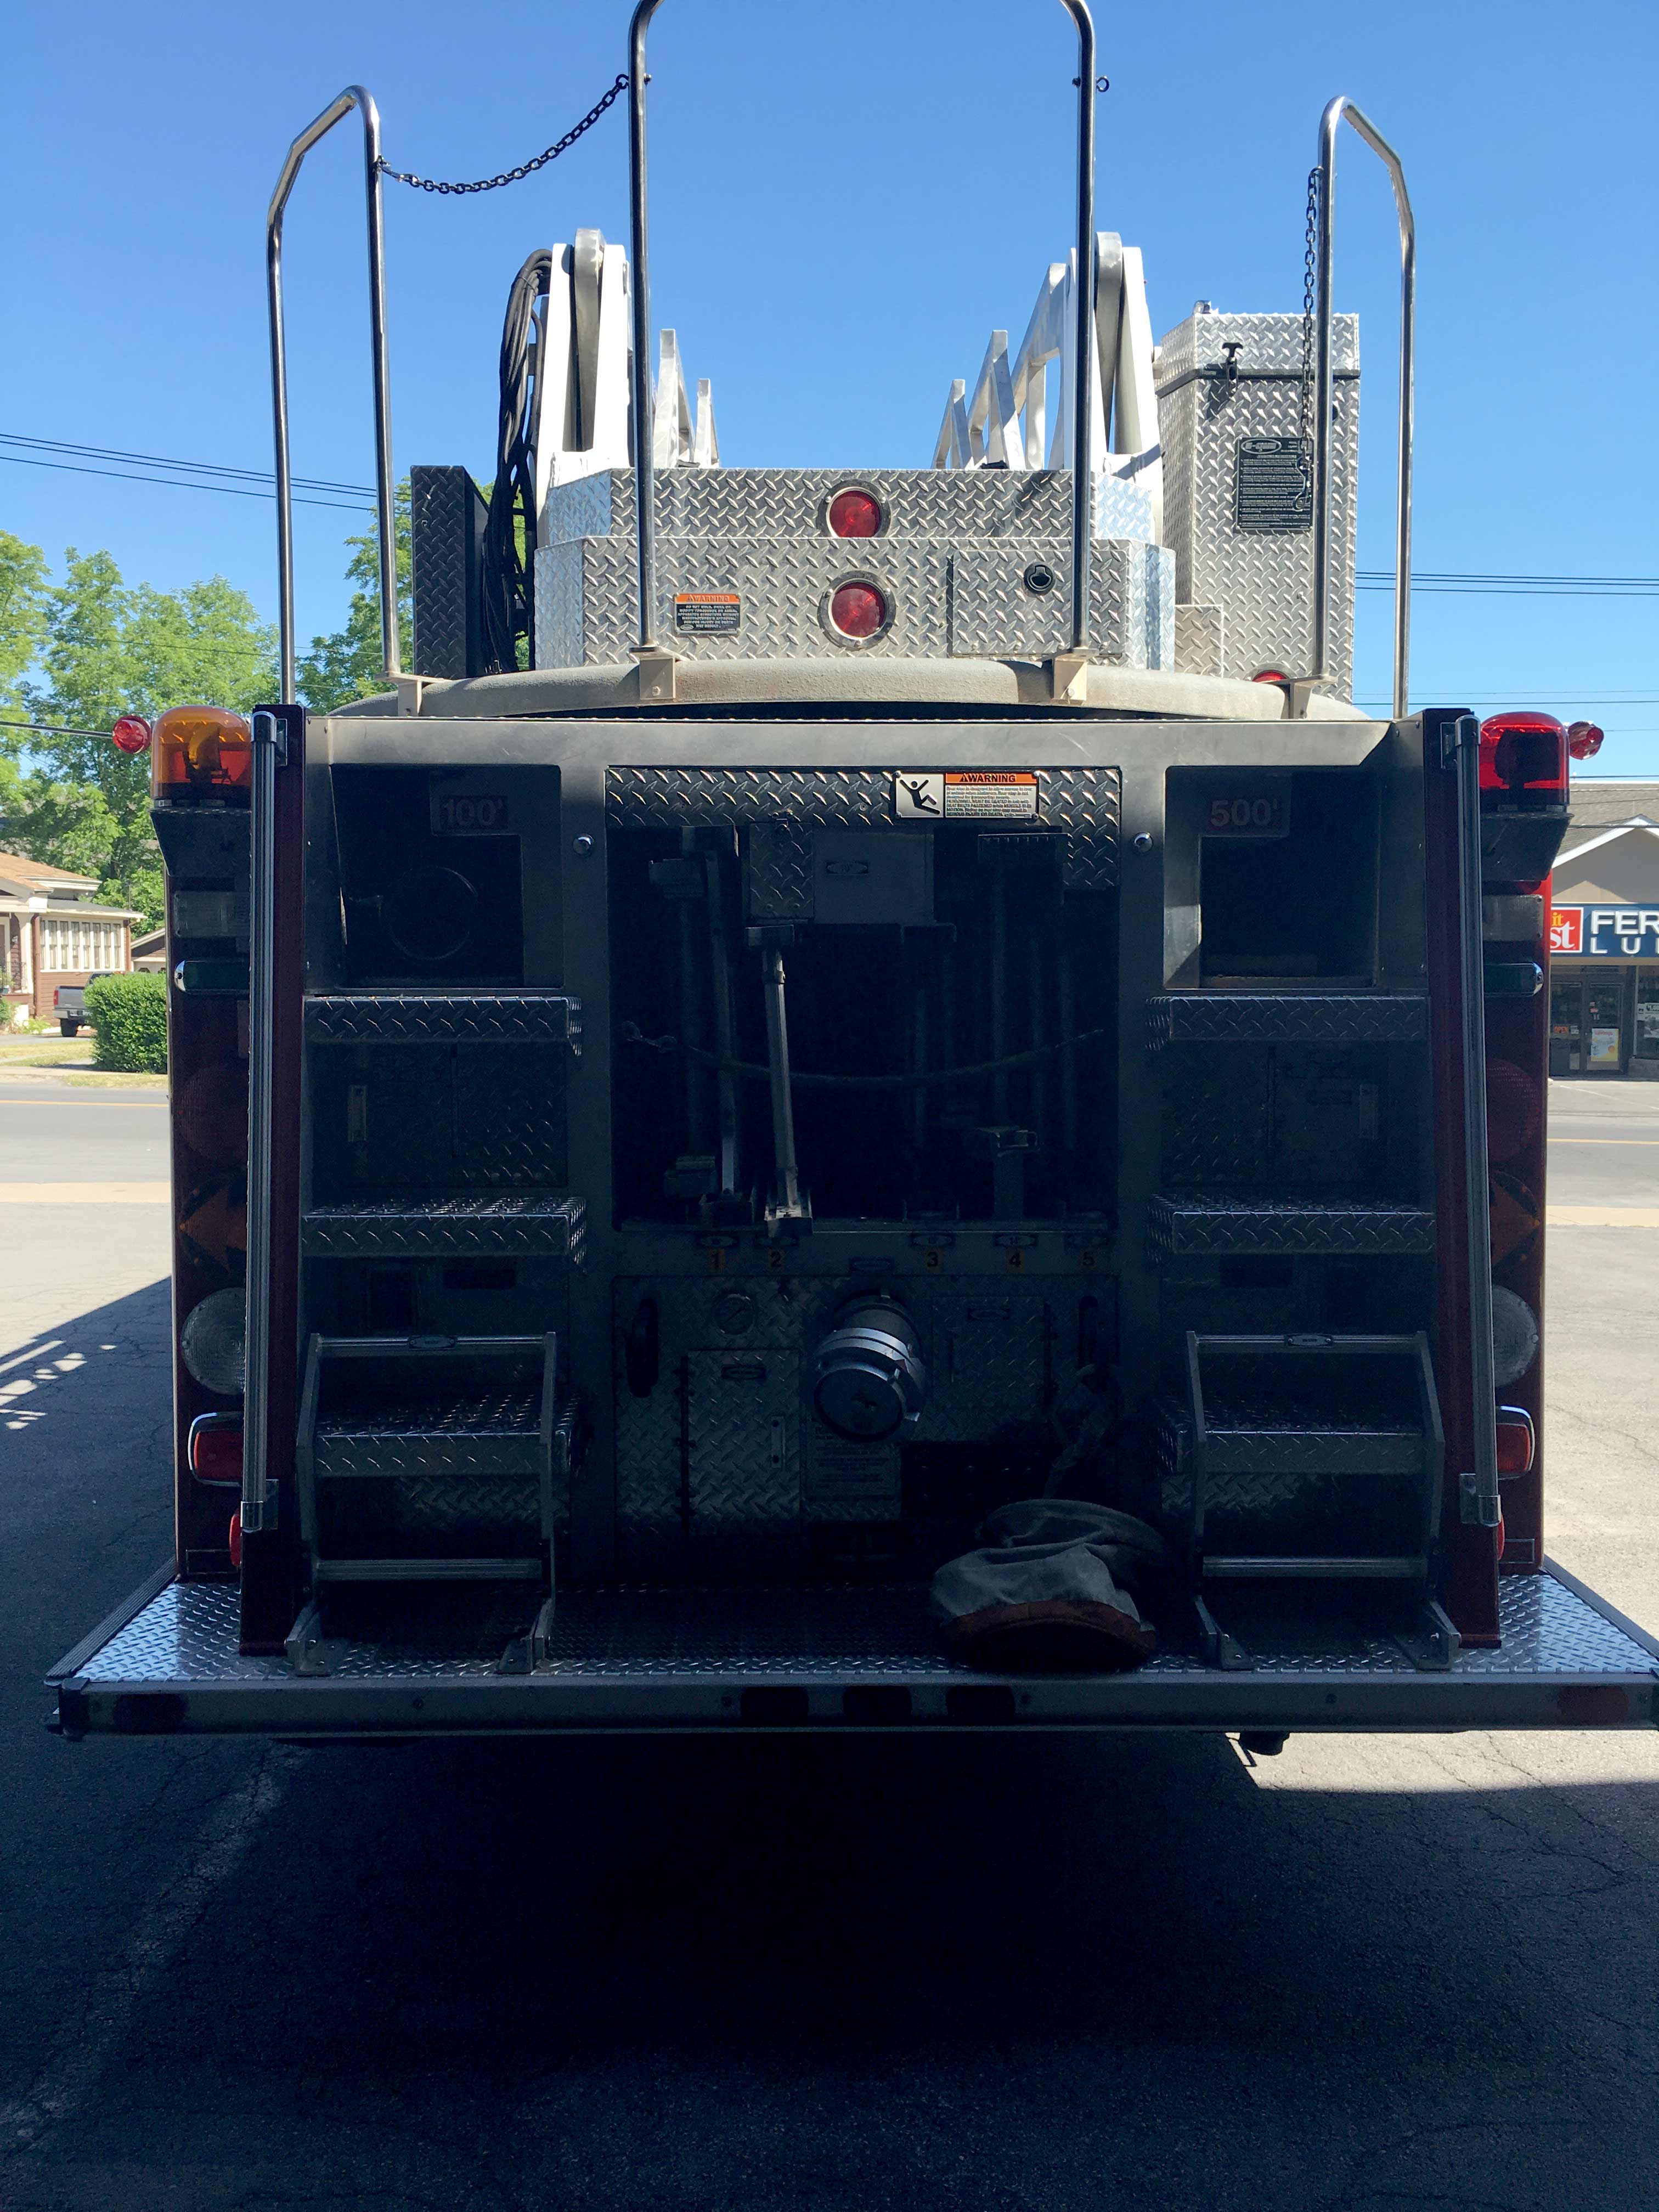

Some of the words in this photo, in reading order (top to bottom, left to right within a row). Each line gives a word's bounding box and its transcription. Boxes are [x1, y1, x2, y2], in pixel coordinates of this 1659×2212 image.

[968, 773, 1015, 782] WARNING
[1551, 912, 1564, 926] it
[1592, 910, 1659, 934] FER
[1590, 937, 1659, 954] LU
[711, 1251, 719, 1267] 1
[770, 1251, 782, 1267] 2
[926, 1251, 939, 1267] 3
[1009, 1251, 1021, 1267] 4
[1082, 1251, 1094, 1267] 5
